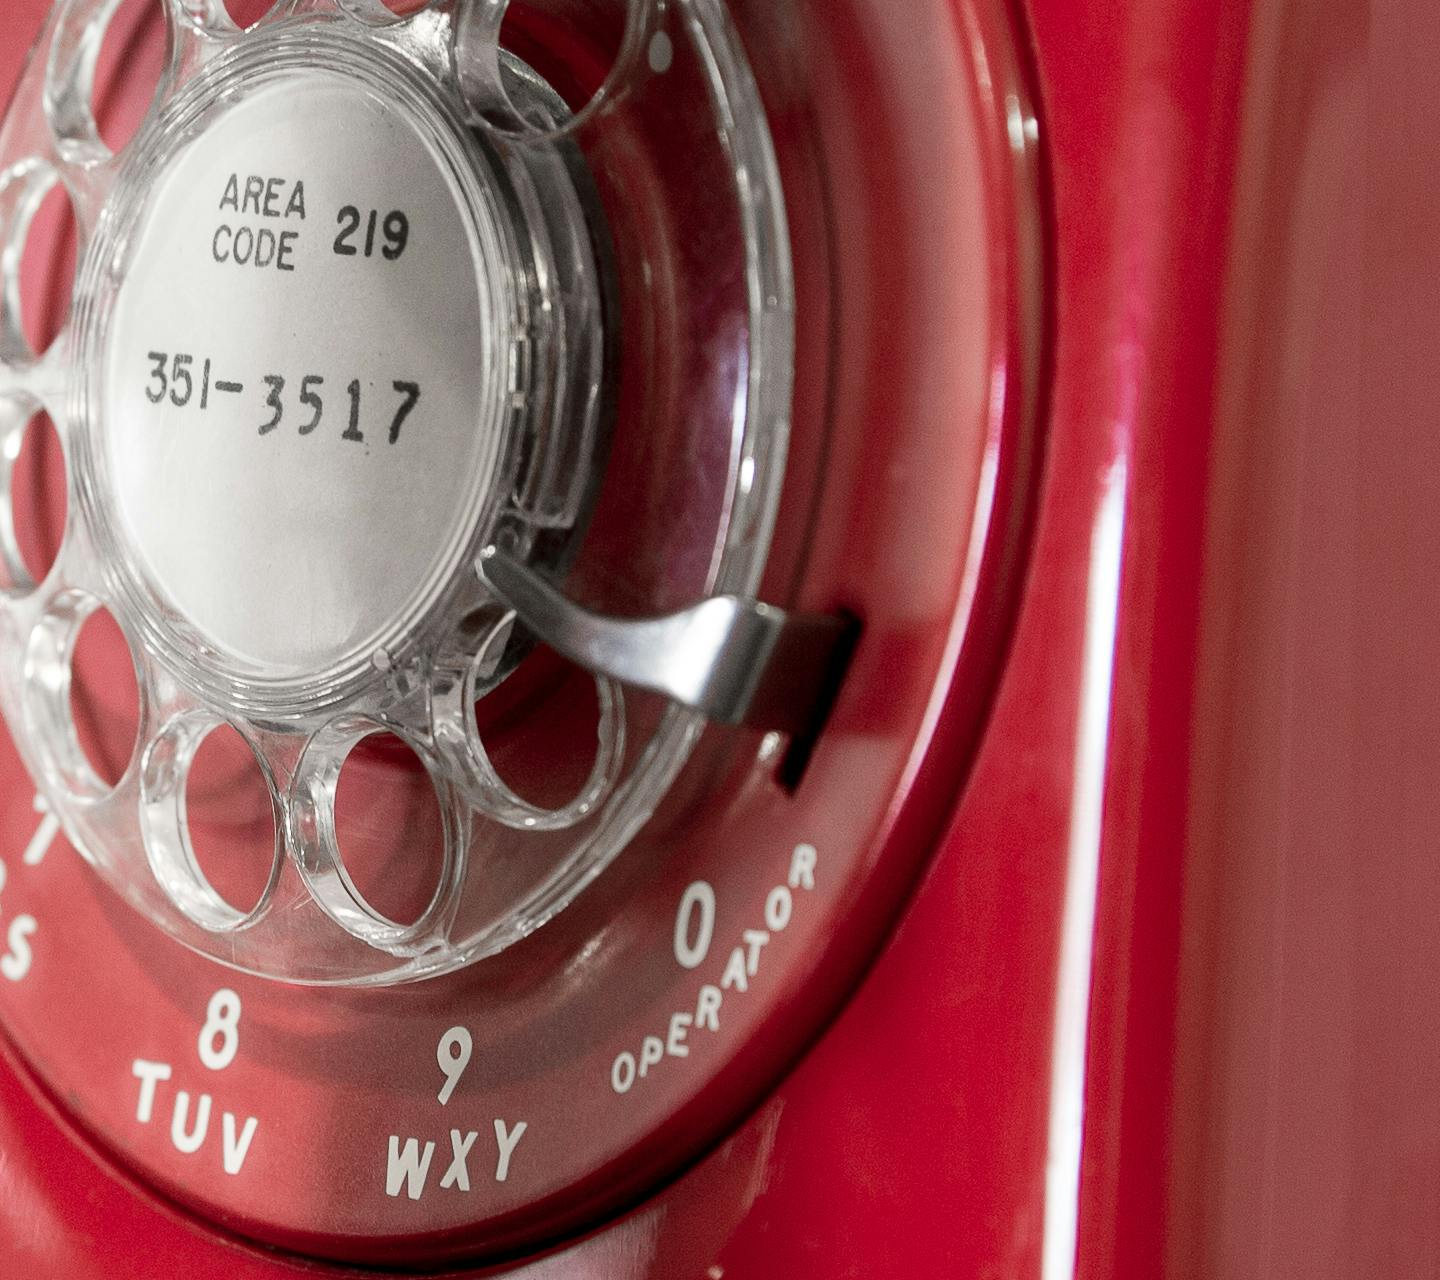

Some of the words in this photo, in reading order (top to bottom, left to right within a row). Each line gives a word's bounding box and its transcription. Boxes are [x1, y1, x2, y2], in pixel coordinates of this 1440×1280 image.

[219, 173, 306, 220] AREA
[212, 224, 298, 271] CODE
[333, 205, 409, 260] 219
[611, 843, 817, 1094] OPERATOR
[198, 988, 242, 1070] 8
[436, 1026, 473, 1105] 9
[132, 1059, 258, 1175] TUV
[385, 1119, 528, 1201] WXY
